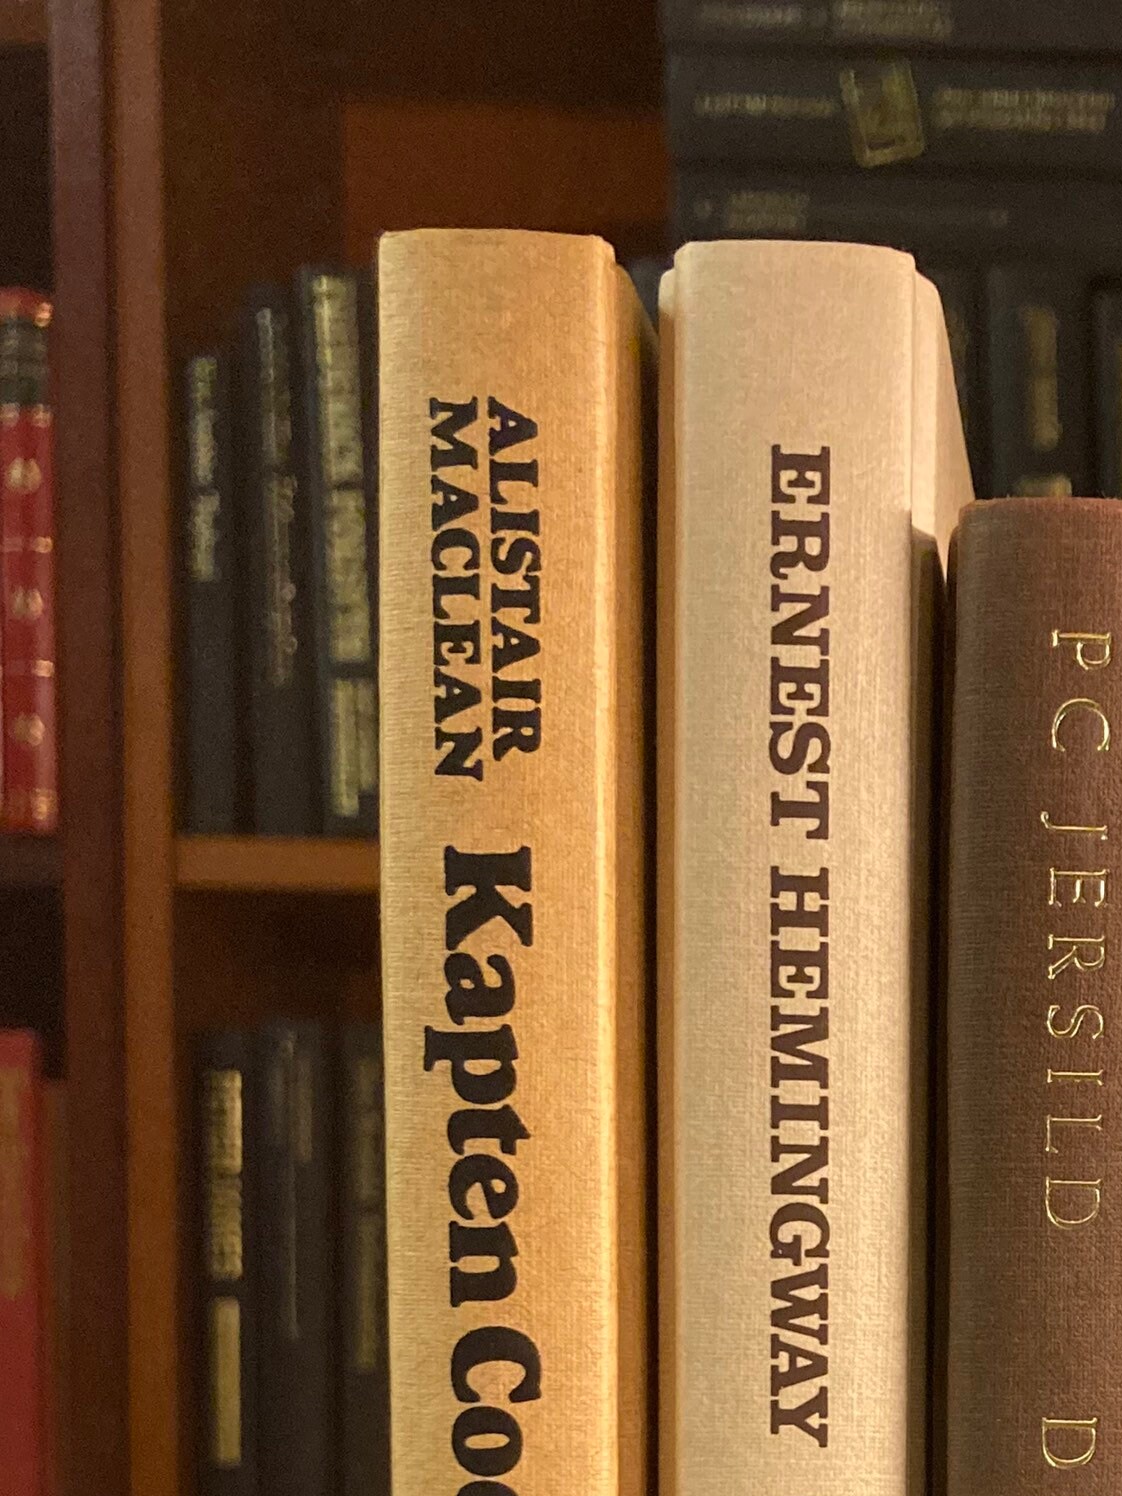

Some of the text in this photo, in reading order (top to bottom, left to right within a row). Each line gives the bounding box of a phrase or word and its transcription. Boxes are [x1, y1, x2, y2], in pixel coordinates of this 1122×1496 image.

[429, 396, 483, 782] MACLEAN
[488, 396, 541, 762] ALISTAIR
[769, 445, 831, 840] ERNEST
[424, 845, 533, 1309] Kapten
[768, 867, 830, 1448] HEMINGWAY
[1040, 811, 1109, 1231] JERSILD
